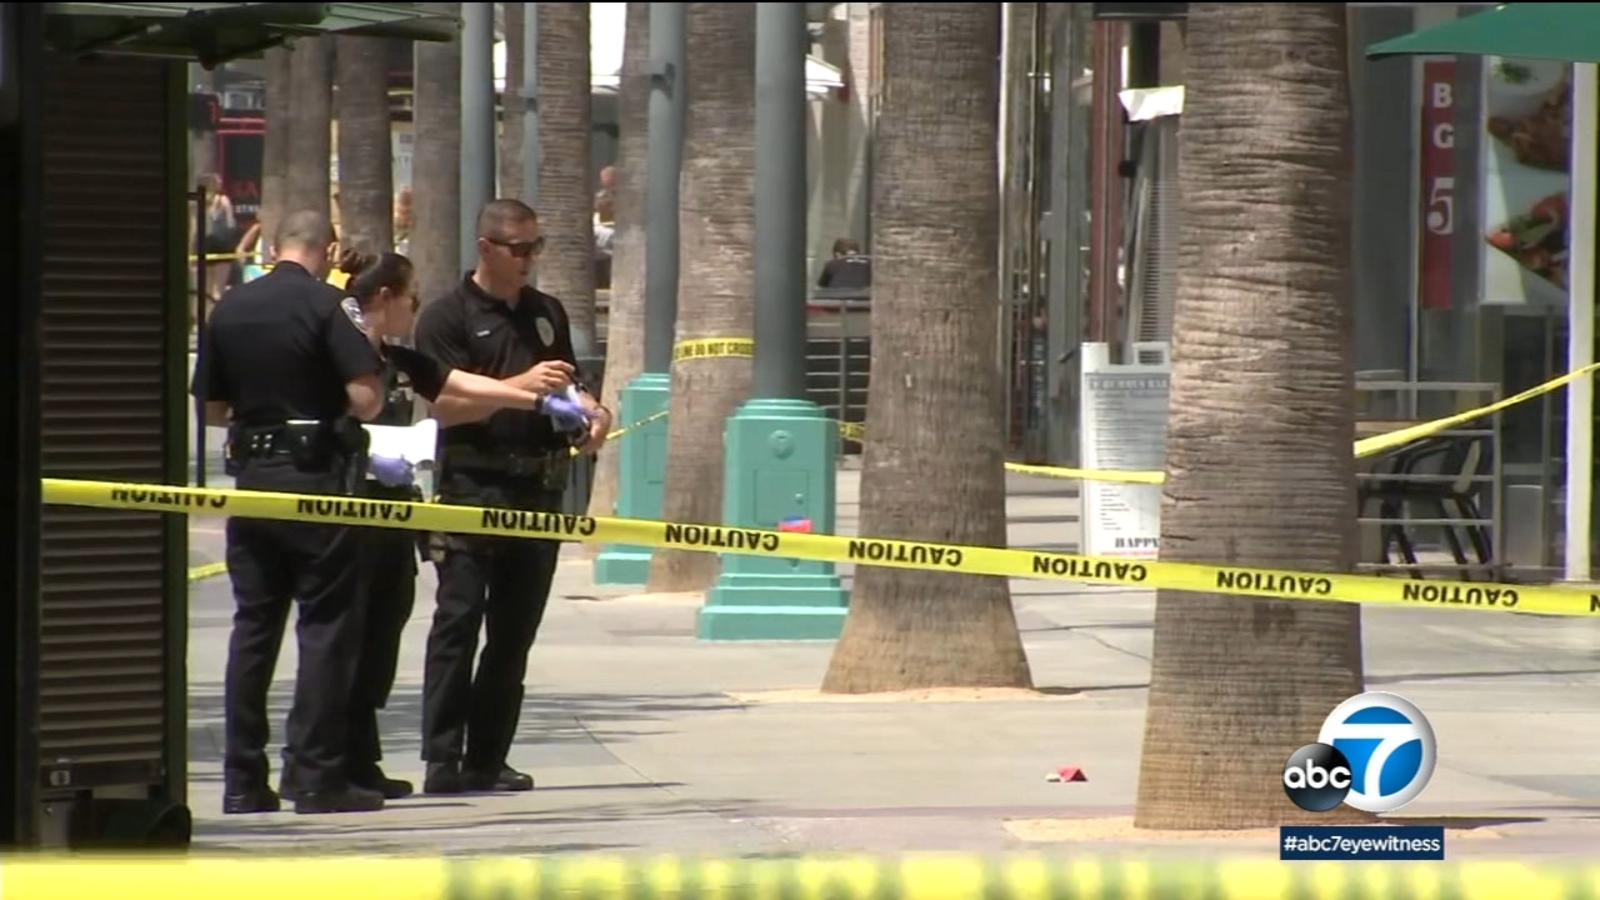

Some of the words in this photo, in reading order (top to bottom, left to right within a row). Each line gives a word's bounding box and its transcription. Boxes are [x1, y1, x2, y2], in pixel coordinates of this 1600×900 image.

[1427, 177, 1455, 235] 5
[297, 498, 413, 522] CAUTION
[481, 509, 596, 536] CAUTION
[665, 523, 779, 551] CAUTION
[849, 540, 963, 567] CAUTION
[1033, 555, 1147, 581] CAUTION
[1217, 571, 1331, 595] CAUTION
[1402, 583, 1519, 608] CAUTION
